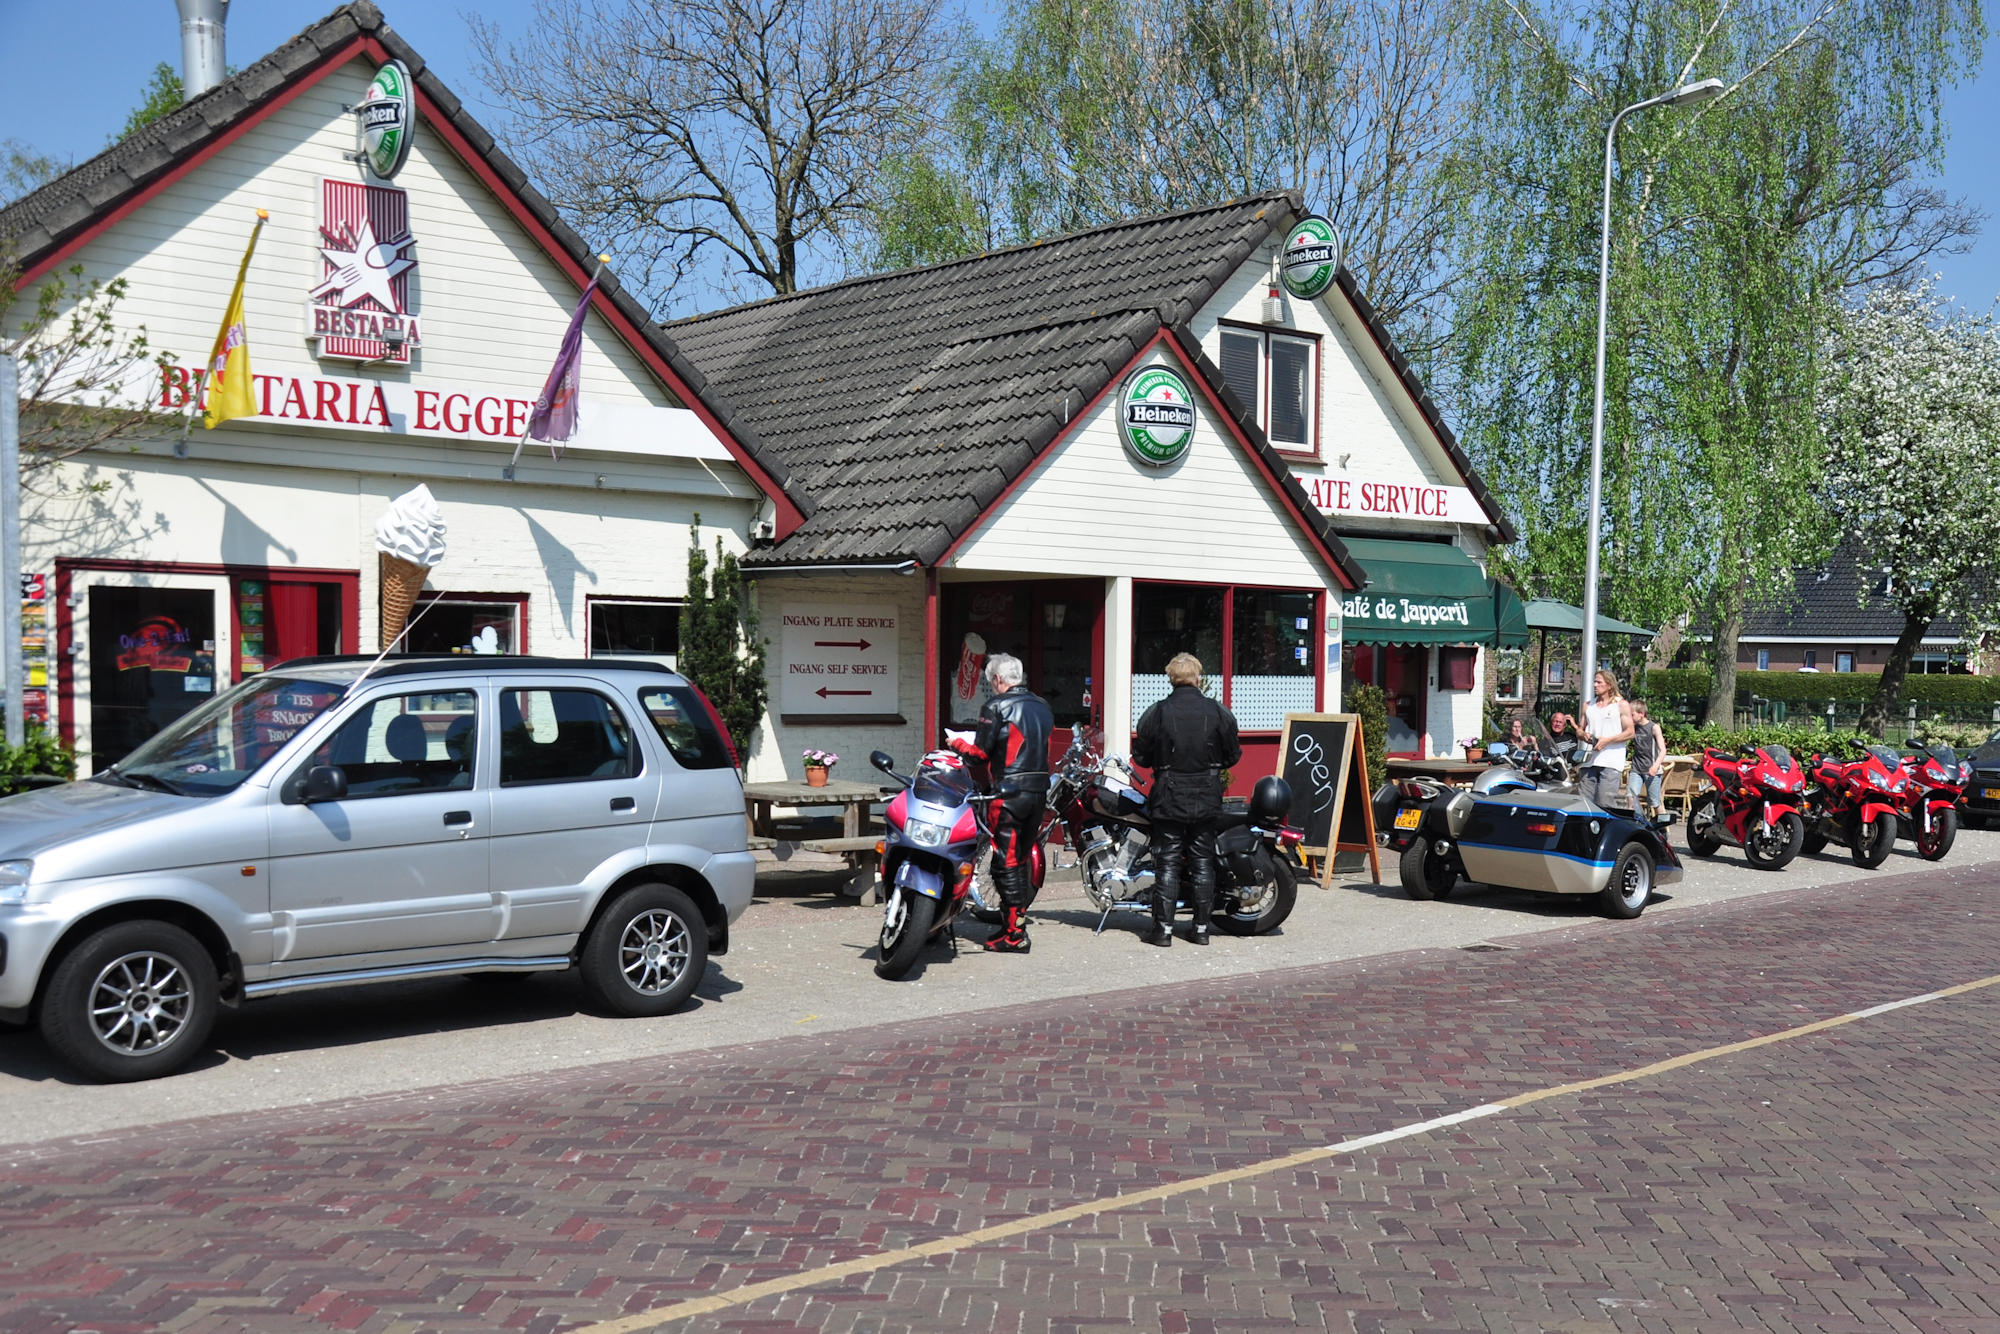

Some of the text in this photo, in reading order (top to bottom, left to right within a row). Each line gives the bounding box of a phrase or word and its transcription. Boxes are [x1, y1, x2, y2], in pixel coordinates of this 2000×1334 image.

[413, 389, 538, 438] EGGE
[1133, 406, 1191, 424] Heineken
[1360, 482, 1448, 517] SERVICE
[783, 615, 895, 629] INGANG PLATE SERVICE
[1375, 598, 1397, 619] de
[1399, 598, 1469, 626] Japperij
[789, 663, 888, 675] INGANG SELF SERVICE
